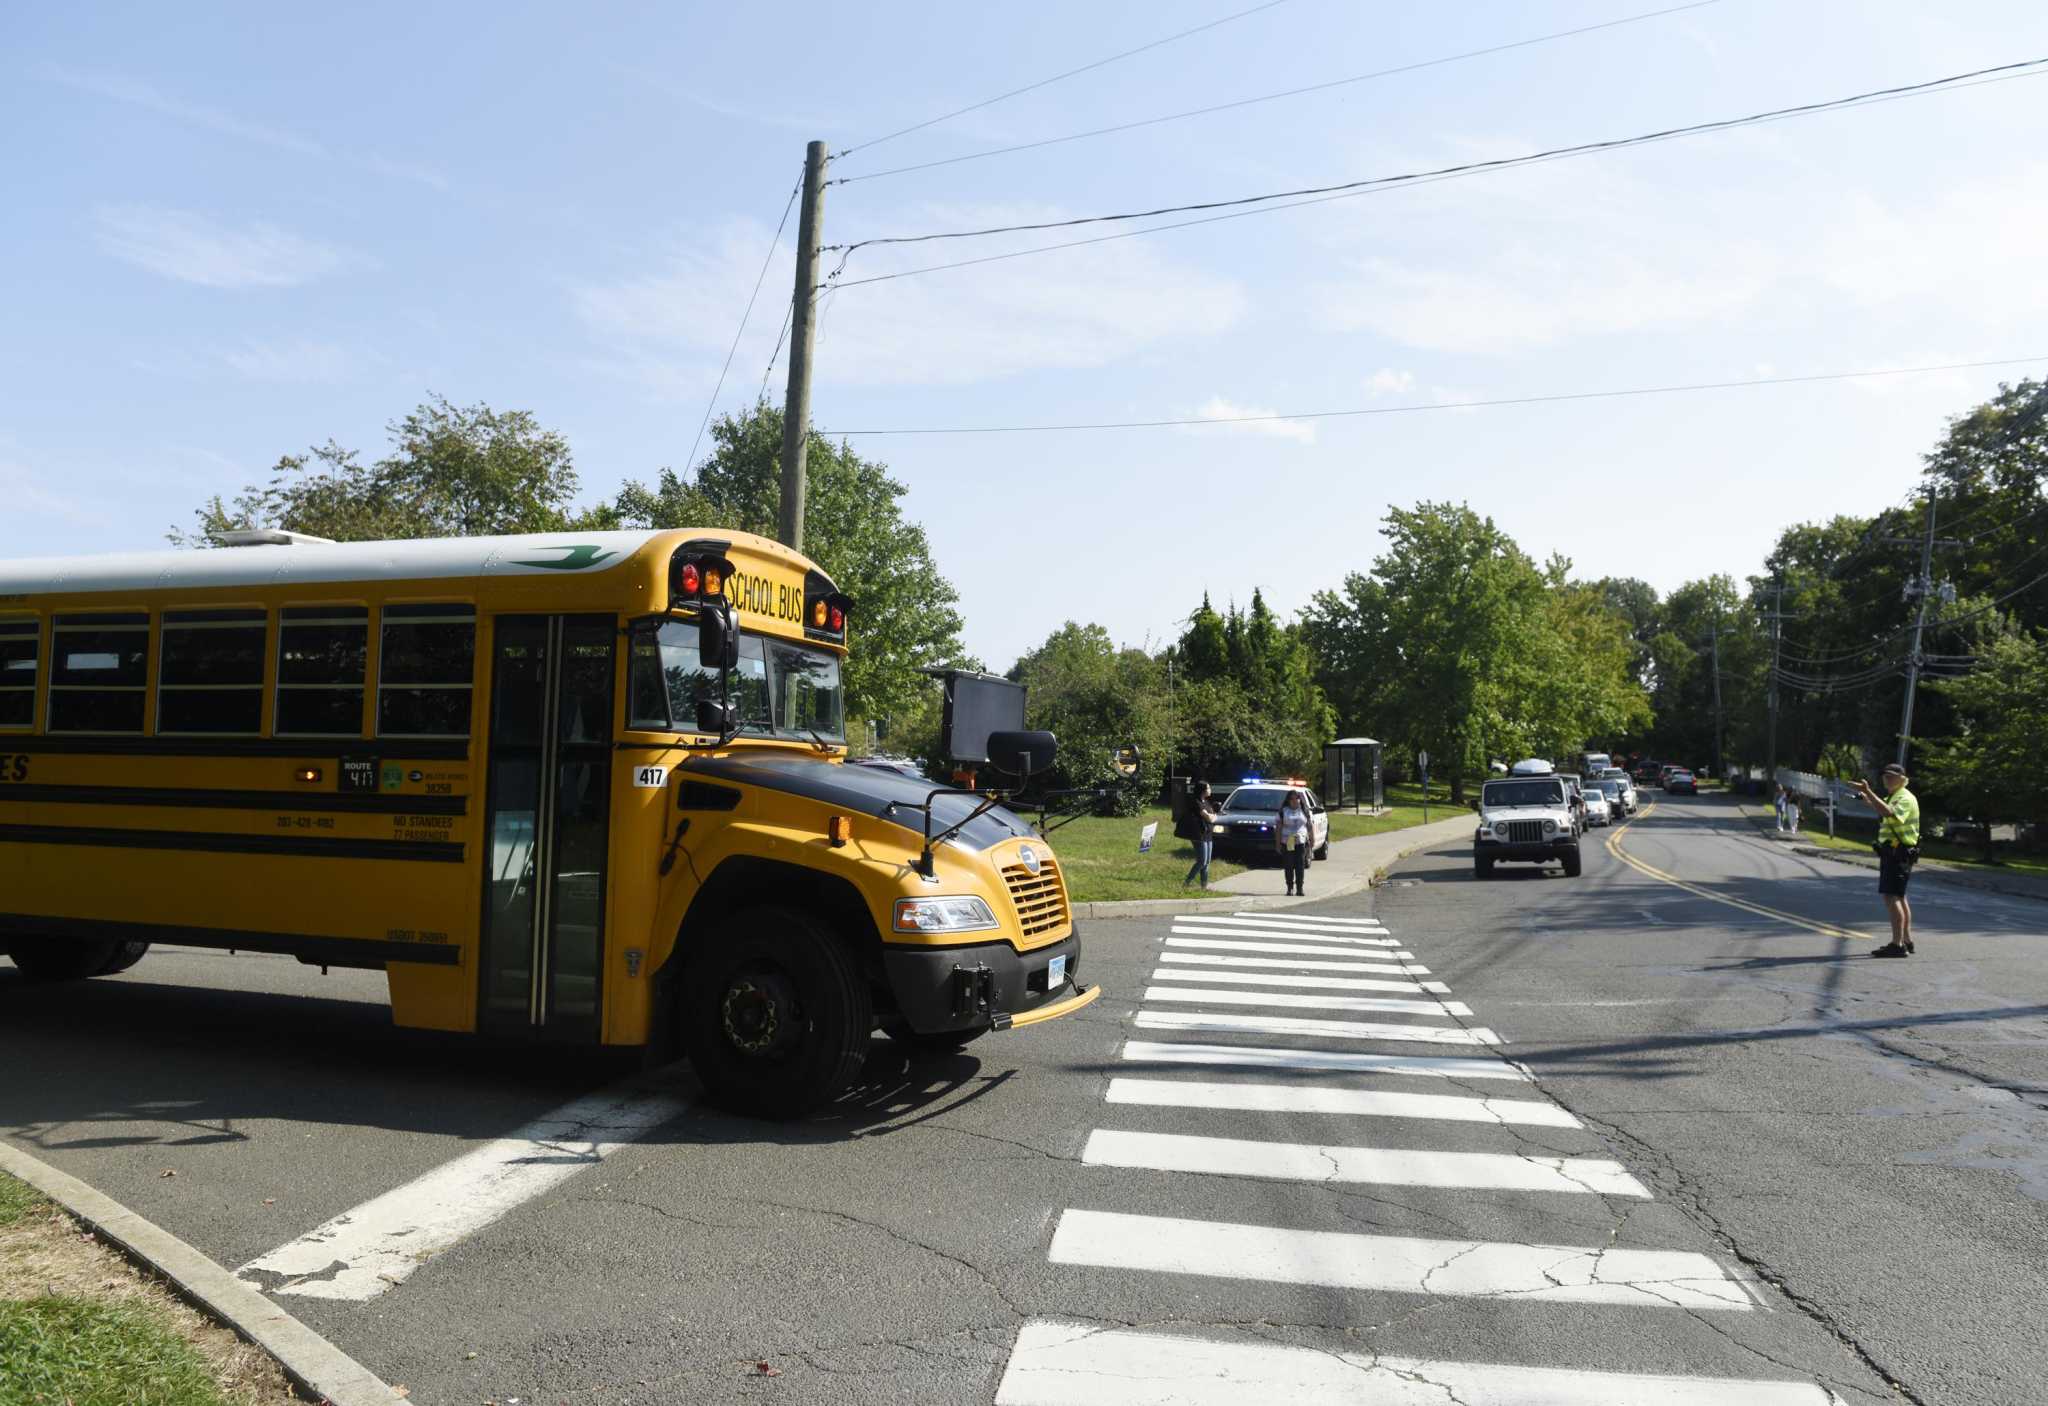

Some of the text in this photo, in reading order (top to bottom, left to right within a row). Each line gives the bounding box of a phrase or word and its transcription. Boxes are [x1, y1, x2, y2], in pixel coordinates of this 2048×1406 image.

[728, 572, 802, 623] SCHOOL BUS
[343, 762, 372, 771] ROUTE
[351, 770, 374, 787] 417
[640, 769, 663, 785] 417
[393, 815, 406, 826] NO
